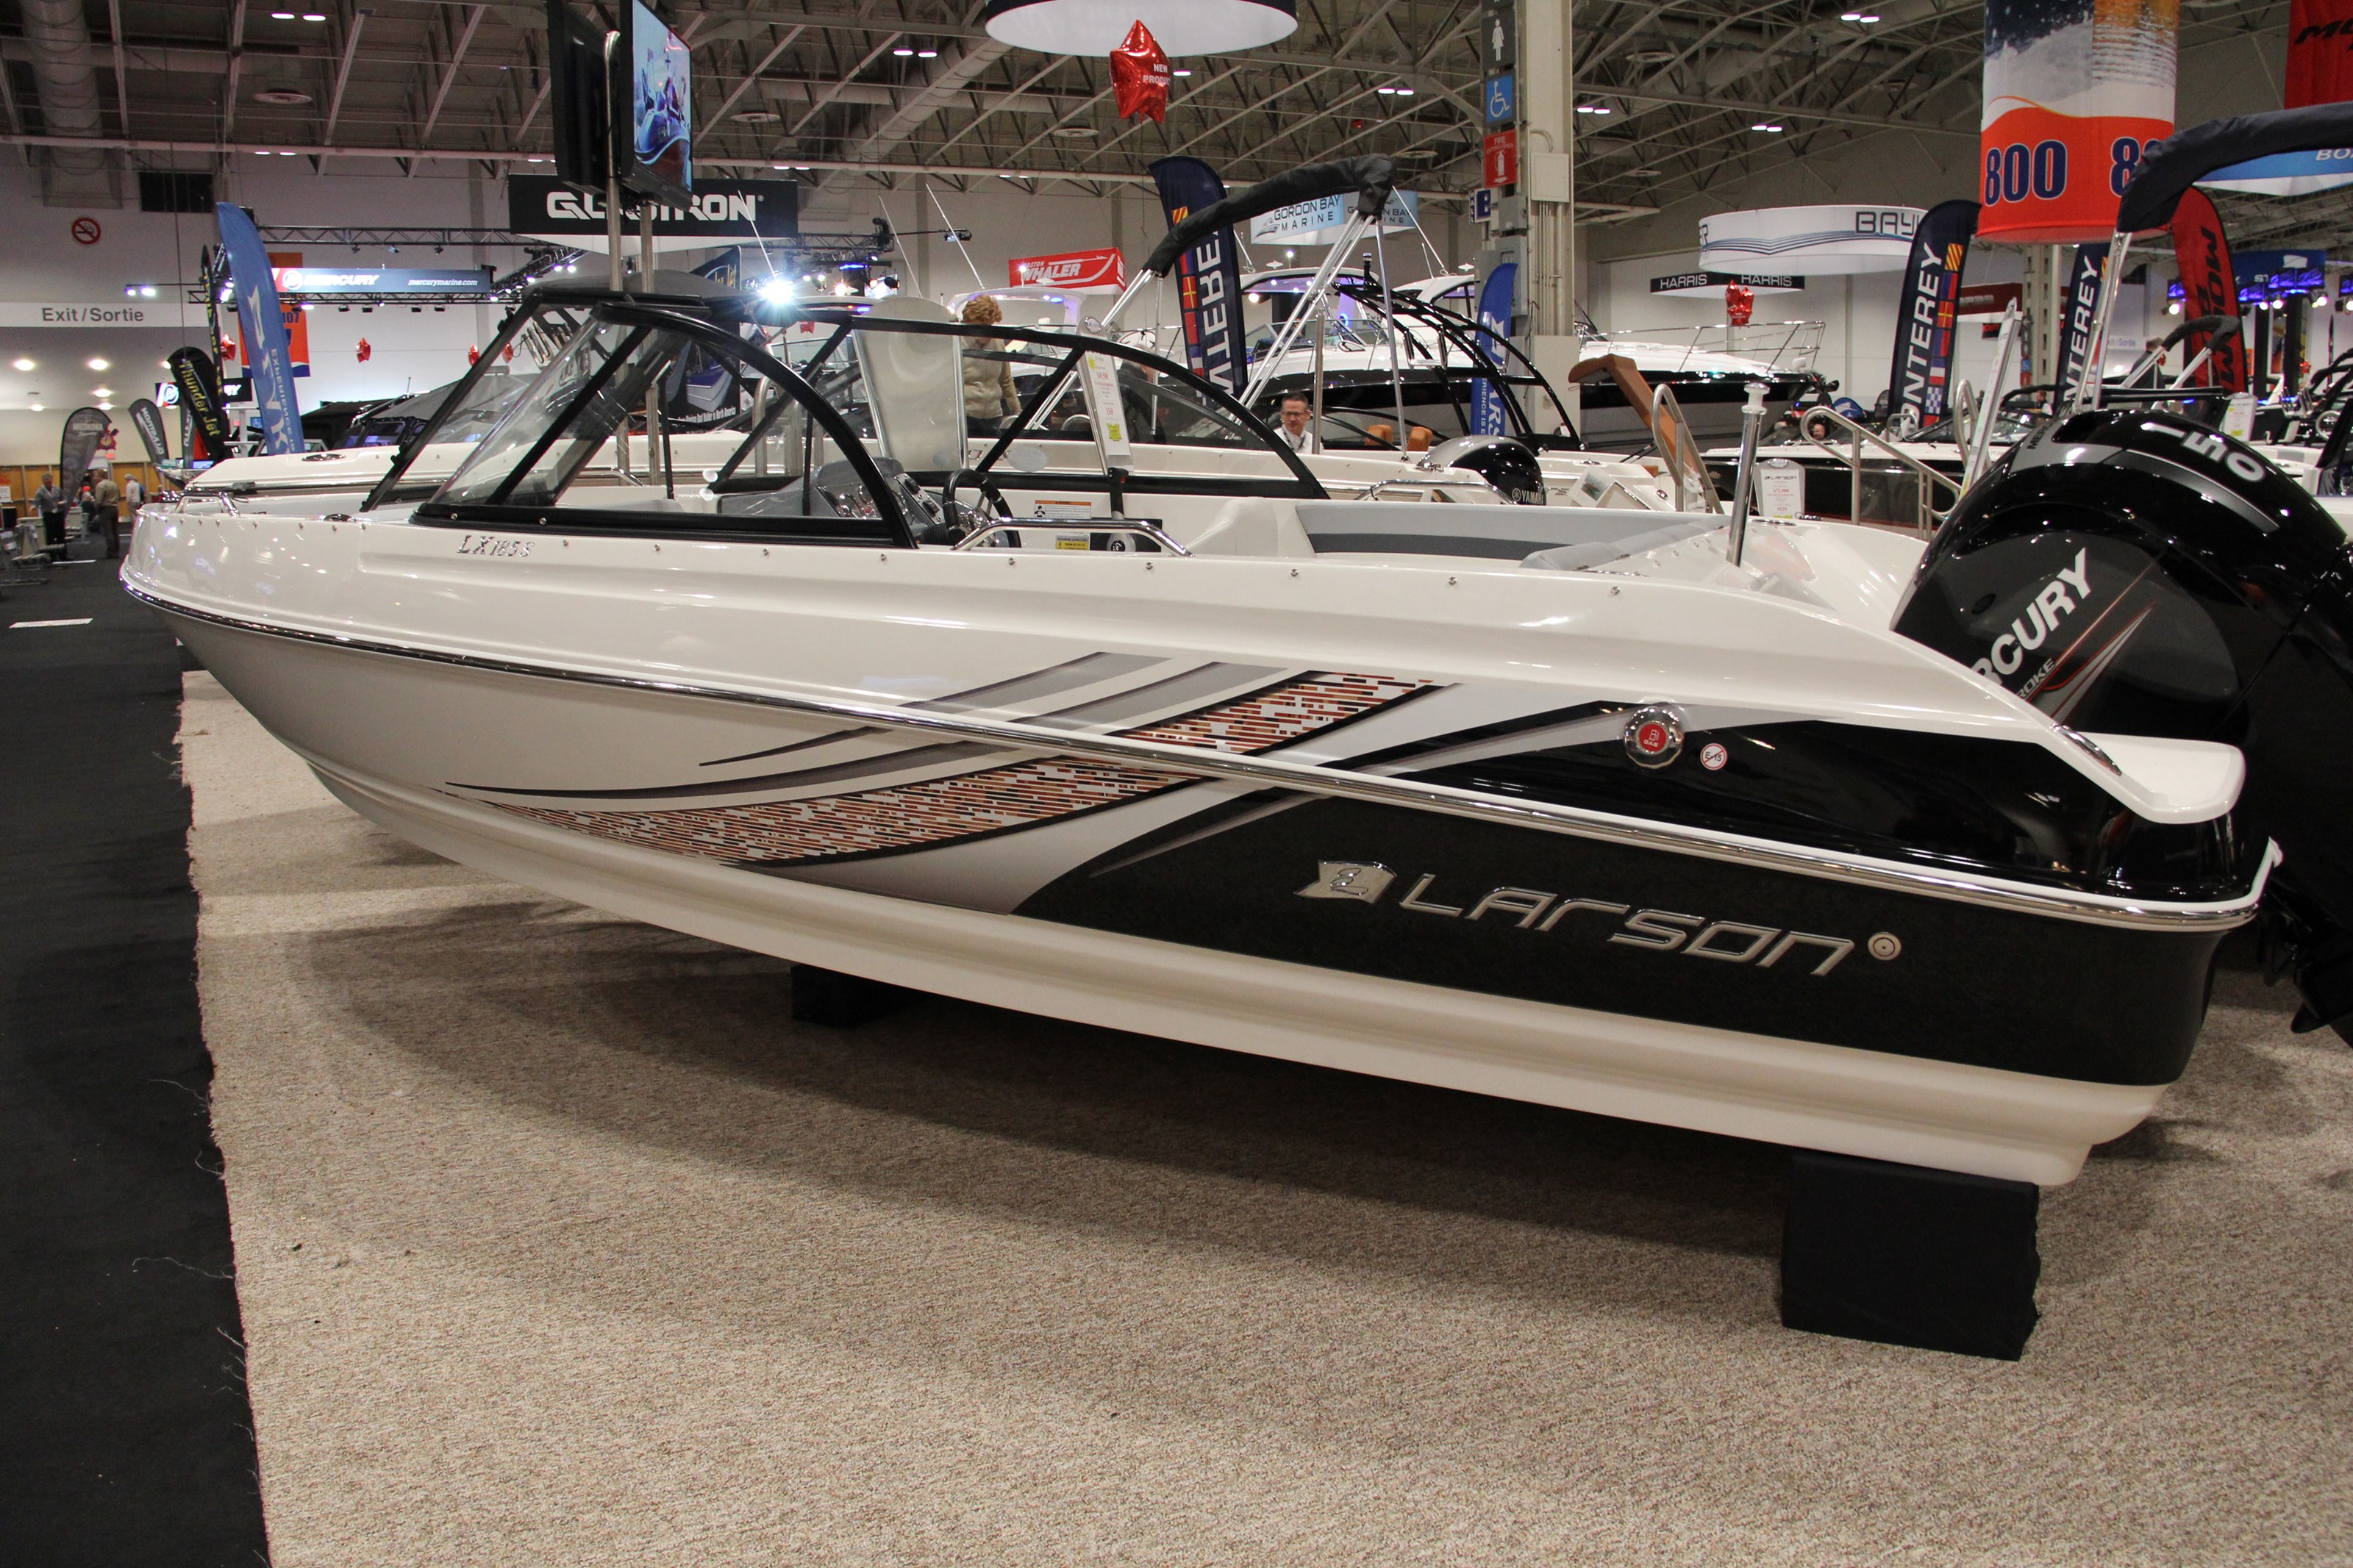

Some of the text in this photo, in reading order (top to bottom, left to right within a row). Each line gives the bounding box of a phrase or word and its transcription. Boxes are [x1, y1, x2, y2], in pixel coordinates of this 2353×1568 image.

[1143, 74, 1171, 85] PRODUC
[1153, 63, 1168, 74] NEW
[1494, 135, 1506, 145] FIRE
[1984, 138, 2068, 207] 800
[546, 191, 757, 221] GLRON
[1274, 194, 1342, 221] GORDON BAY
[1281, 211, 1334, 232] MARINE
[1021, 262, 1082, 282] WHALER
[1660, 274, 1708, 290] HARRIS
[1740, 275, 1793, 287] HARRIS
[41, 307, 79, 322] Exit
[89, 307, 145, 322] Sortie
[1899, 241, 1942, 428] ONTEREY
[2063, 255, 2098, 402] NTEREY
[179, 359, 209, 414] Thunder
[203, 413, 220, 437] Jet
[2140, 421, 2266, 482] 150
[1970, 546, 2092, 686] RCURY
[2015, 657, 2057, 699] ROKE
[1643, 739, 1659, 748] GAS
